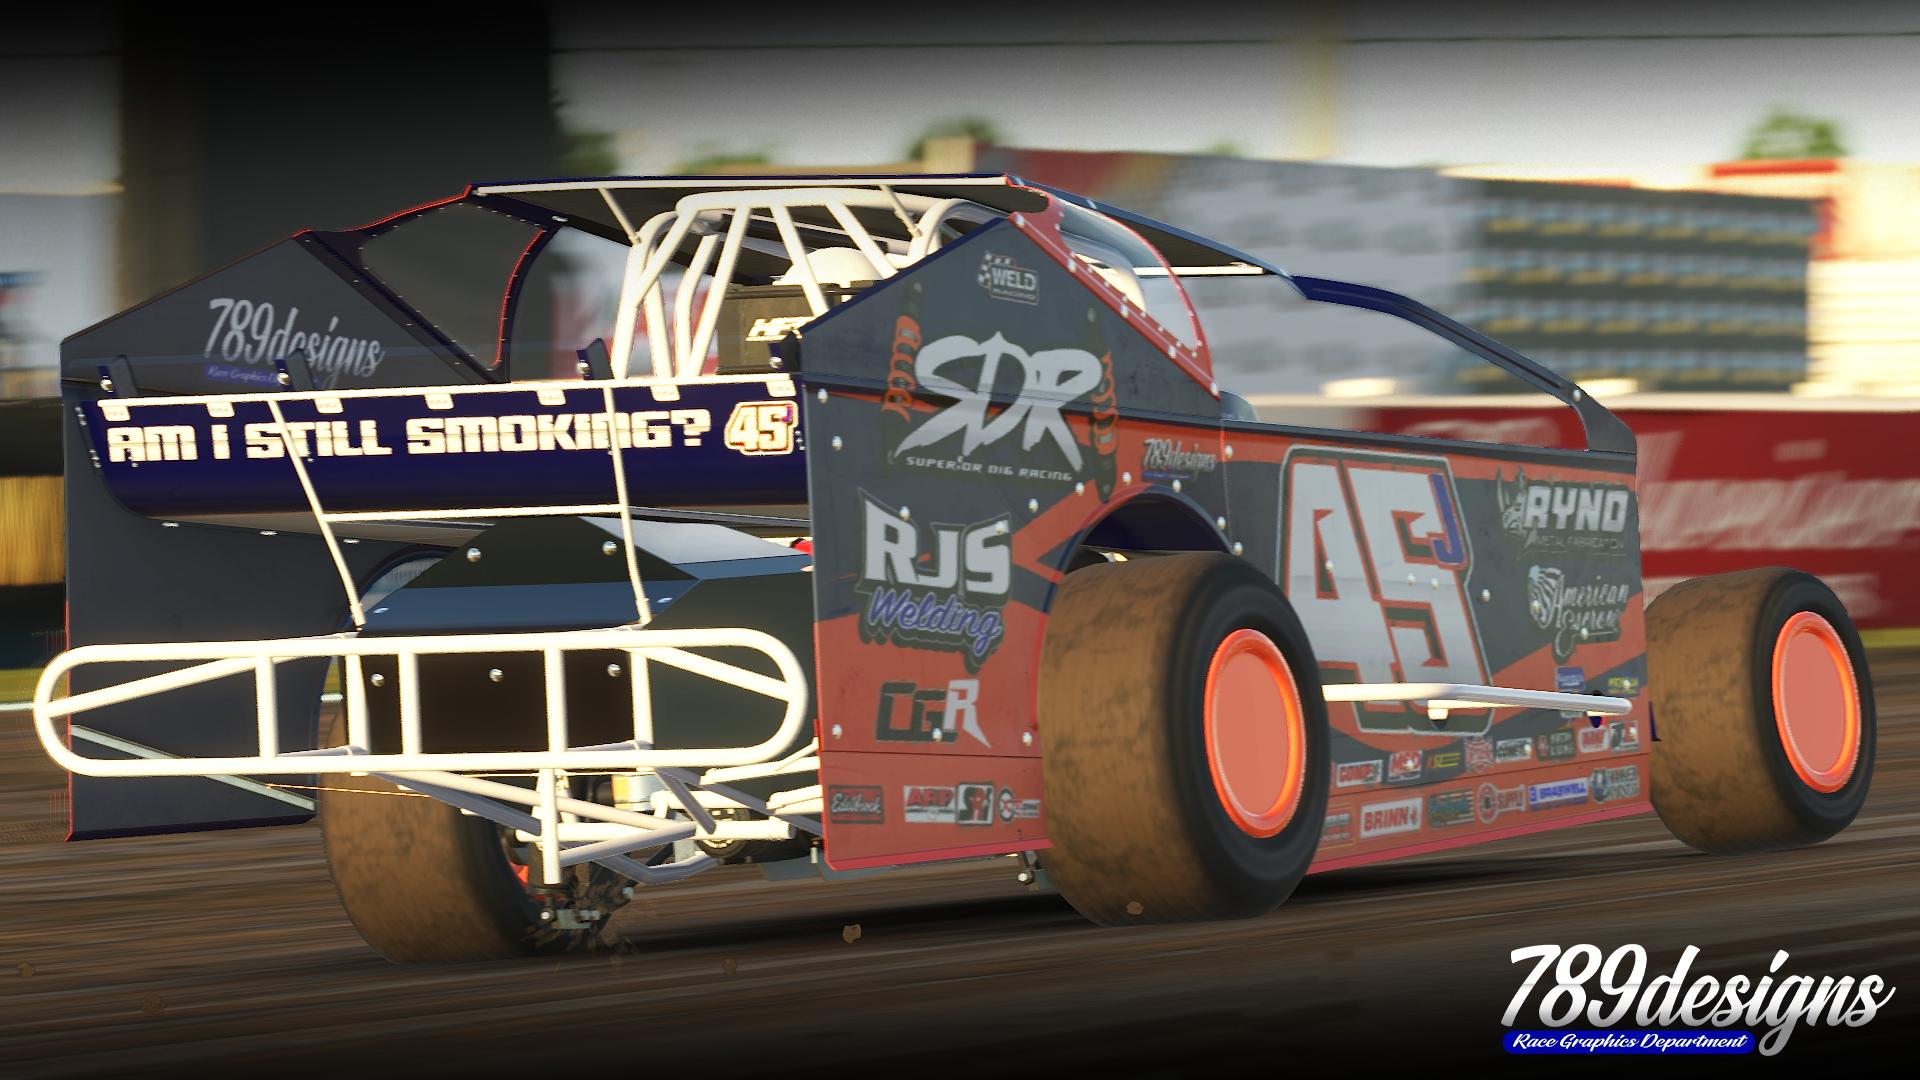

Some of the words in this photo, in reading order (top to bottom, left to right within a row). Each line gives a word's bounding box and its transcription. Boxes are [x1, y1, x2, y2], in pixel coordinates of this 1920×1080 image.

[991, 266, 1036, 291] WELD
[204, 298, 386, 388] 789designs
[894, 331, 1102, 472] SDR
[107, 425, 198, 463] AM
[245, 420, 393, 459] STILL
[406, 408, 710, 455] SMOKING?
[1018, 468, 1073, 481] RACING
[1524, 485, 1629, 533] RYNO
[864, 499, 1011, 595] RJS
[867, 586, 1004, 657] Welding
[908, 788, 955, 808] ARP
[1364, 805, 1410, 832] BRINN
